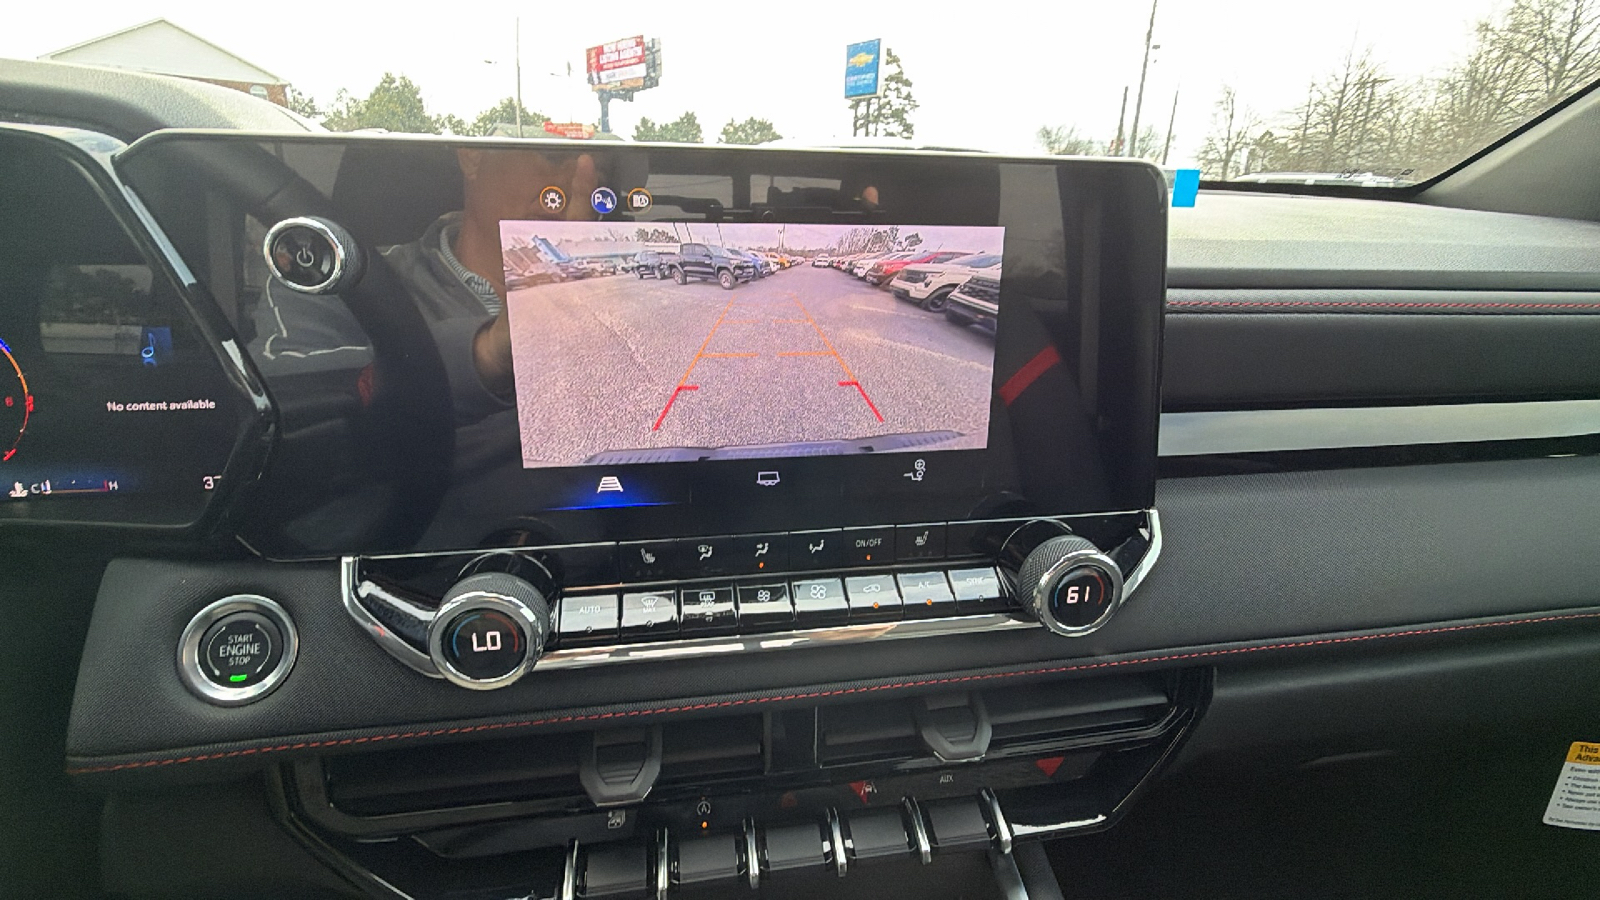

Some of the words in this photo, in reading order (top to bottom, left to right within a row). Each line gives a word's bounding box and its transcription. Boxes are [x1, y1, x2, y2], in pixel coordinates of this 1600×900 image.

[106, 401, 124, 412] No
[126, 401, 168, 411] content
[169, 399, 216, 411] available
[30, 483, 41, 494] C
[108, 480, 119, 491] H
[855, 538, 882, 548] ON/OFF
[1066, 586, 1090, 604] 61
[579, 606, 601, 614] AUTO
[227, 633, 253, 643] START
[219, 642, 261, 657] ENGINE
[228, 656, 251, 666] STOP
[1579, 744, 1599, 754] This
[1575, 753, 1600, 762] Adva
[939, 774, 954, 784] AUX
